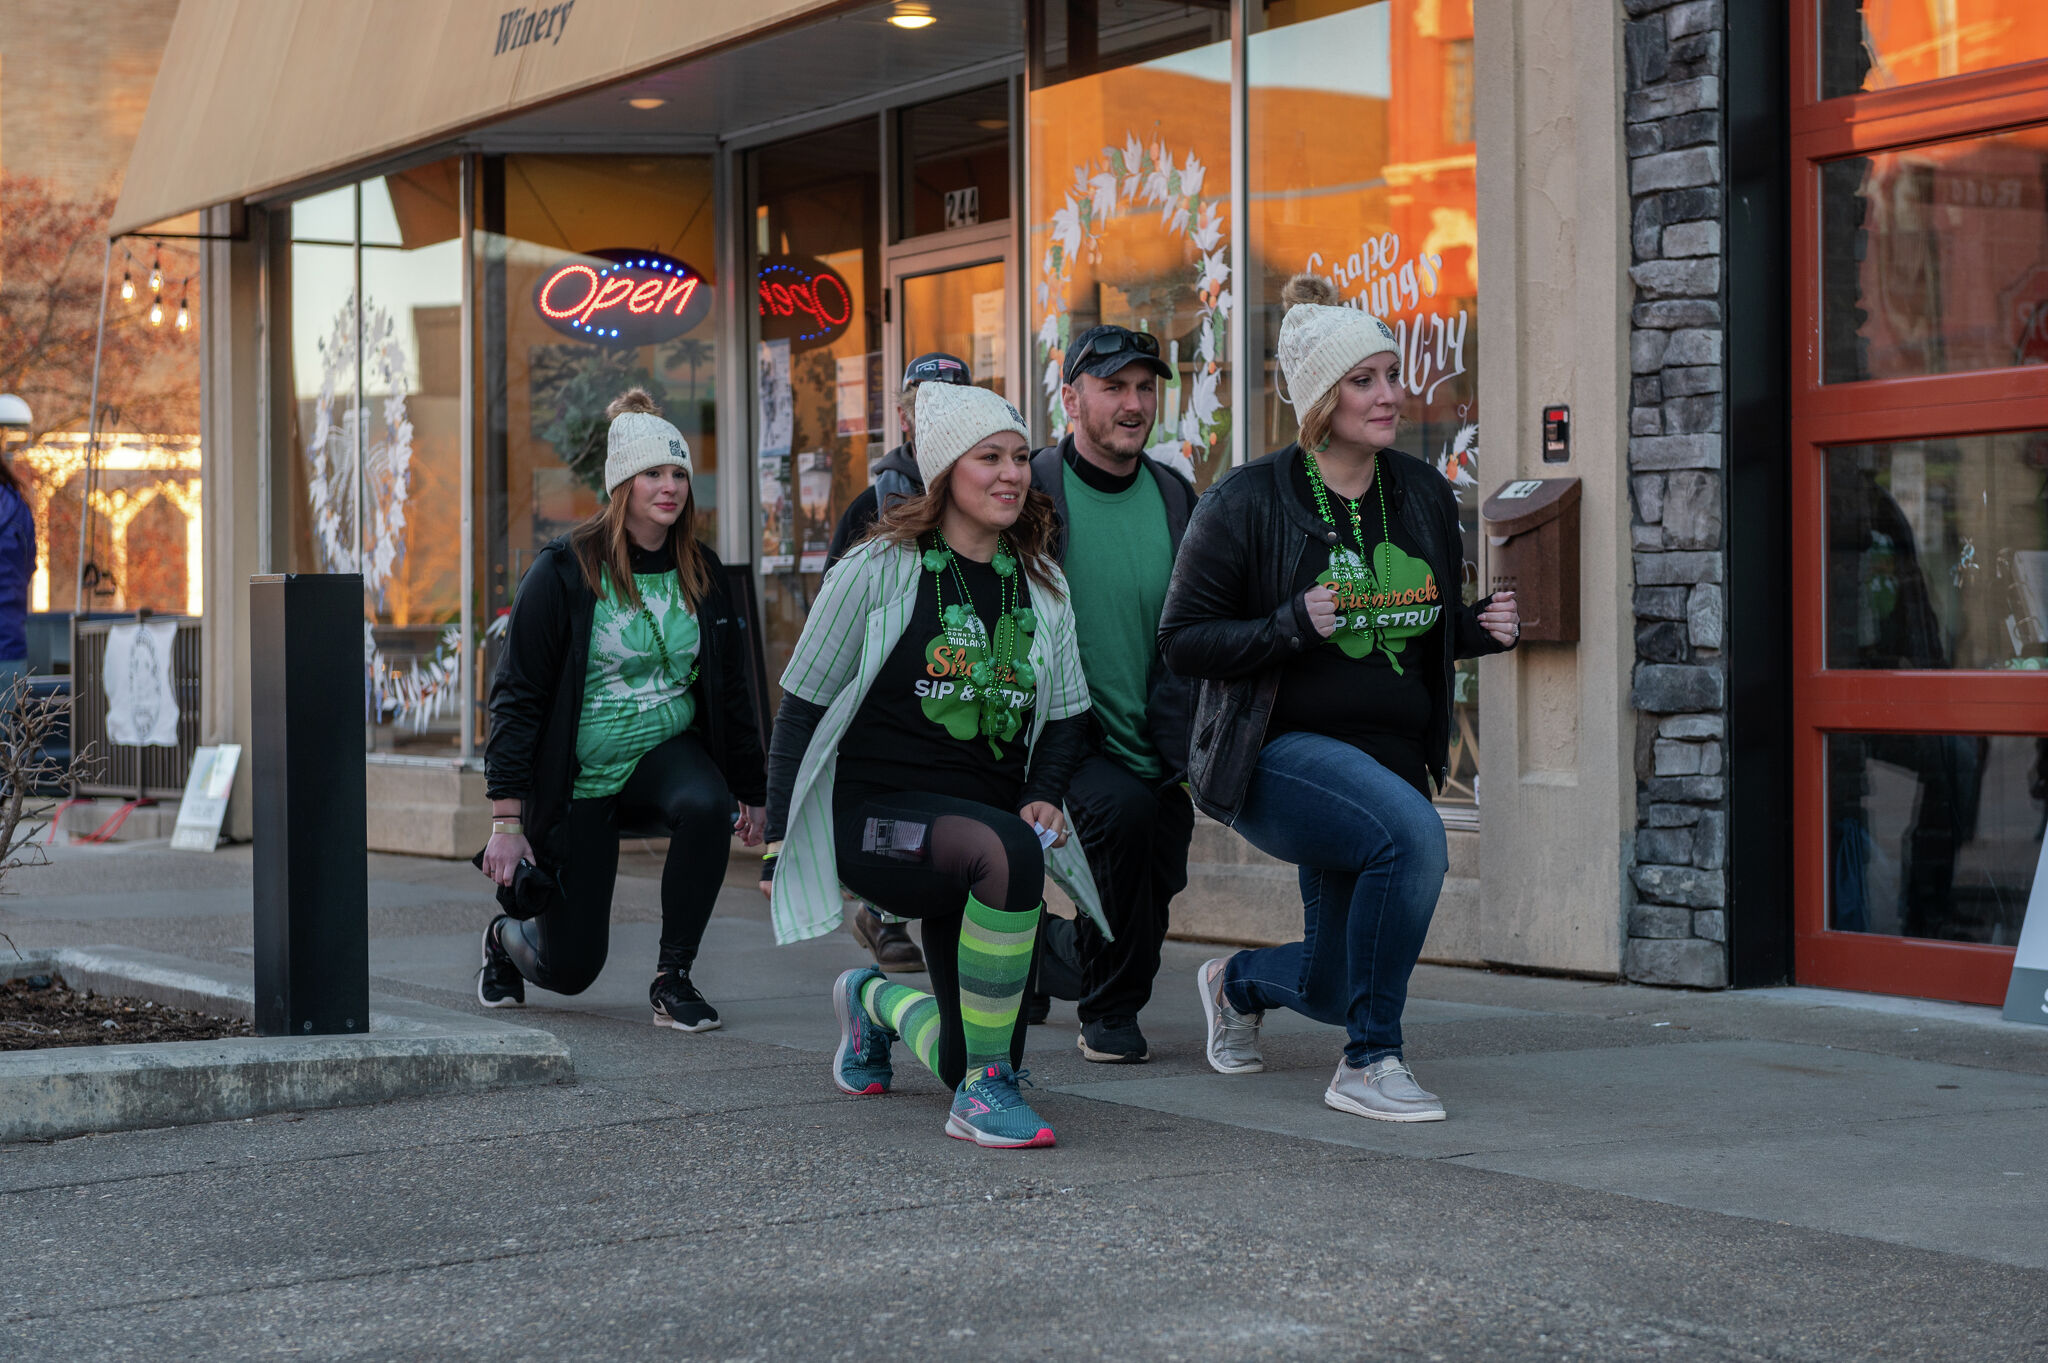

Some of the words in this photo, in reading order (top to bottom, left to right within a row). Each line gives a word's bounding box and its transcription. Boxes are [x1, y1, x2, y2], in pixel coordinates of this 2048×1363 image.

[494, 0, 576, 57] Winery
[946, 189, 978, 229] 244
[540, 264, 699, 323] Open
[1323, 574, 1440, 611] Shamrock
[947, 631, 987, 640] DOWNTON
[1353, 615, 1370, 630] &
[1375, 604, 1443, 630] STRUT
[914, 679, 955, 701] SIP
[960, 684, 976, 702] &
